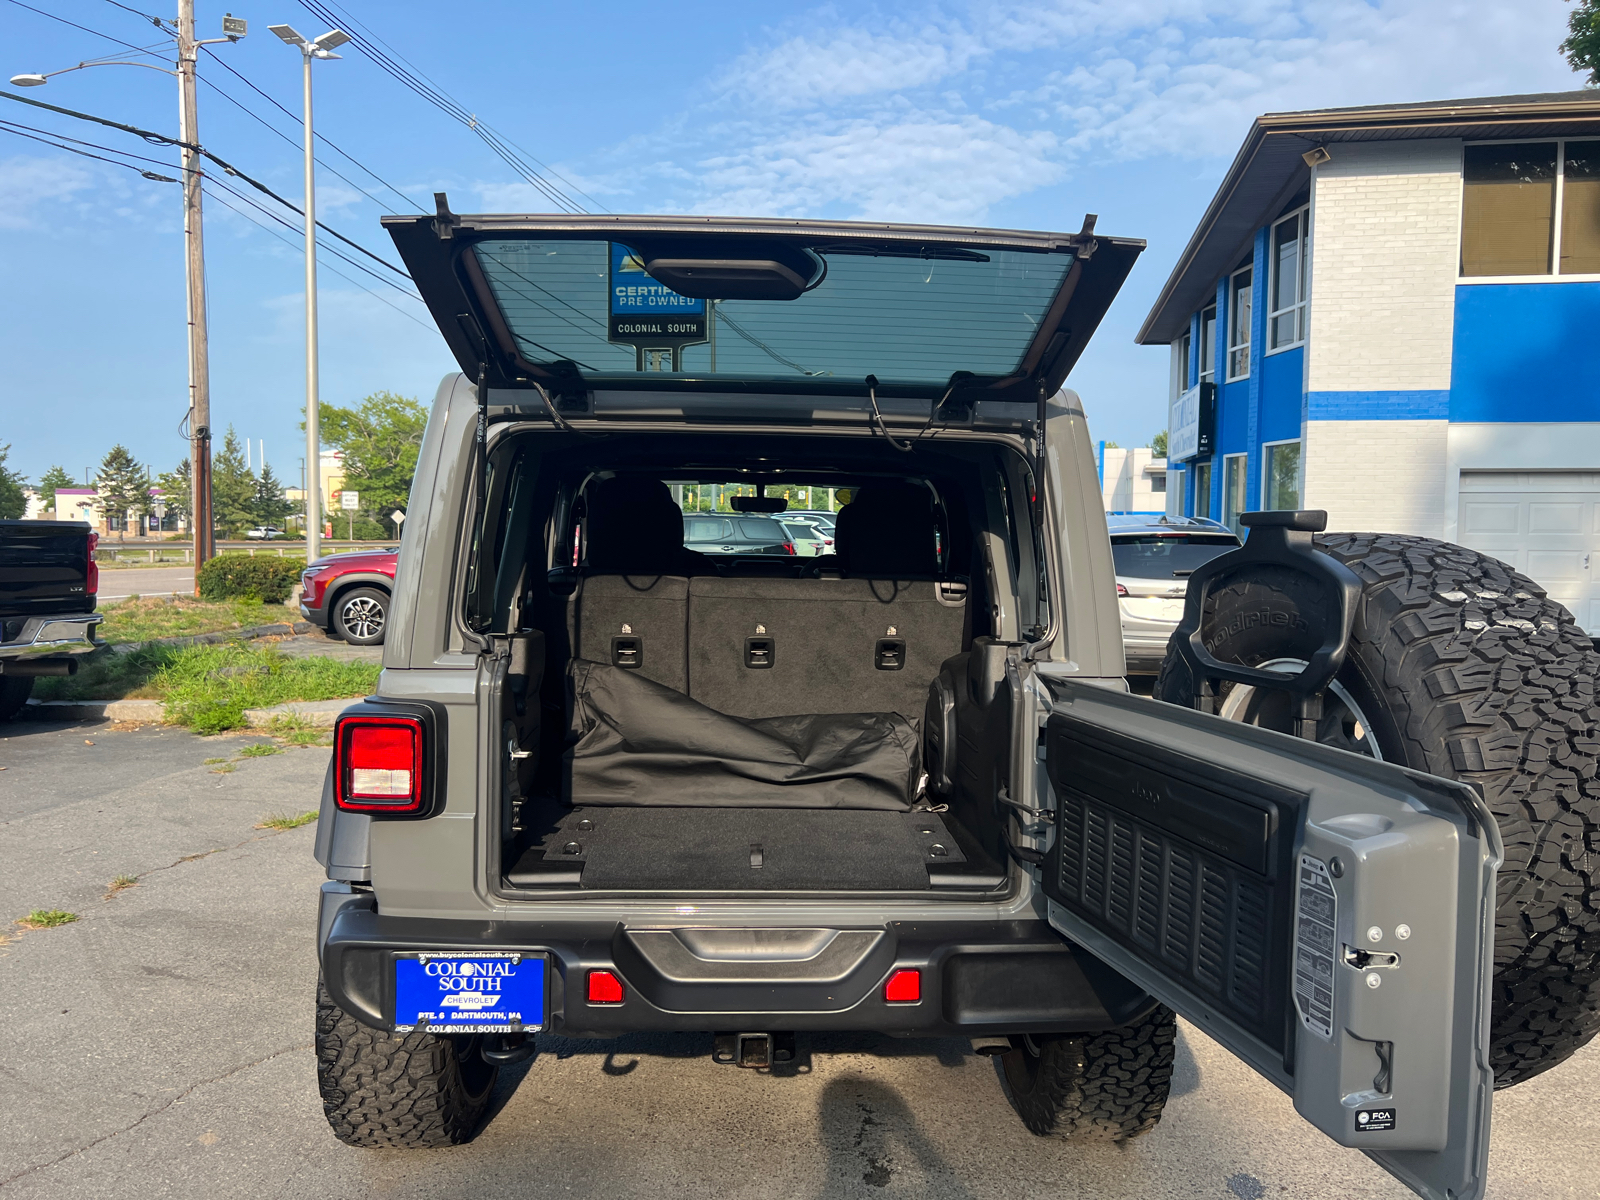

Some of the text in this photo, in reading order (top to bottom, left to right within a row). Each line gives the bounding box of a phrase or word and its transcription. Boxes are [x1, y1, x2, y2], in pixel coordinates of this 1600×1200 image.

[620, 296, 695, 306] PRE-OWNED
[618, 323, 697, 333] COLONIAL SOUTH
[1302, 872, 1331, 889] JL
[425, 961, 516, 977] COLONIAL
[439, 977, 502, 990] SOUTH
[1314, 991, 1331, 1005] USA
[451, 1012, 507, 1020] DARTMOUTH,
[426, 1025, 512, 1033] COLONIAL SOUTH
[1372, 1112, 1391, 1120] FCA
